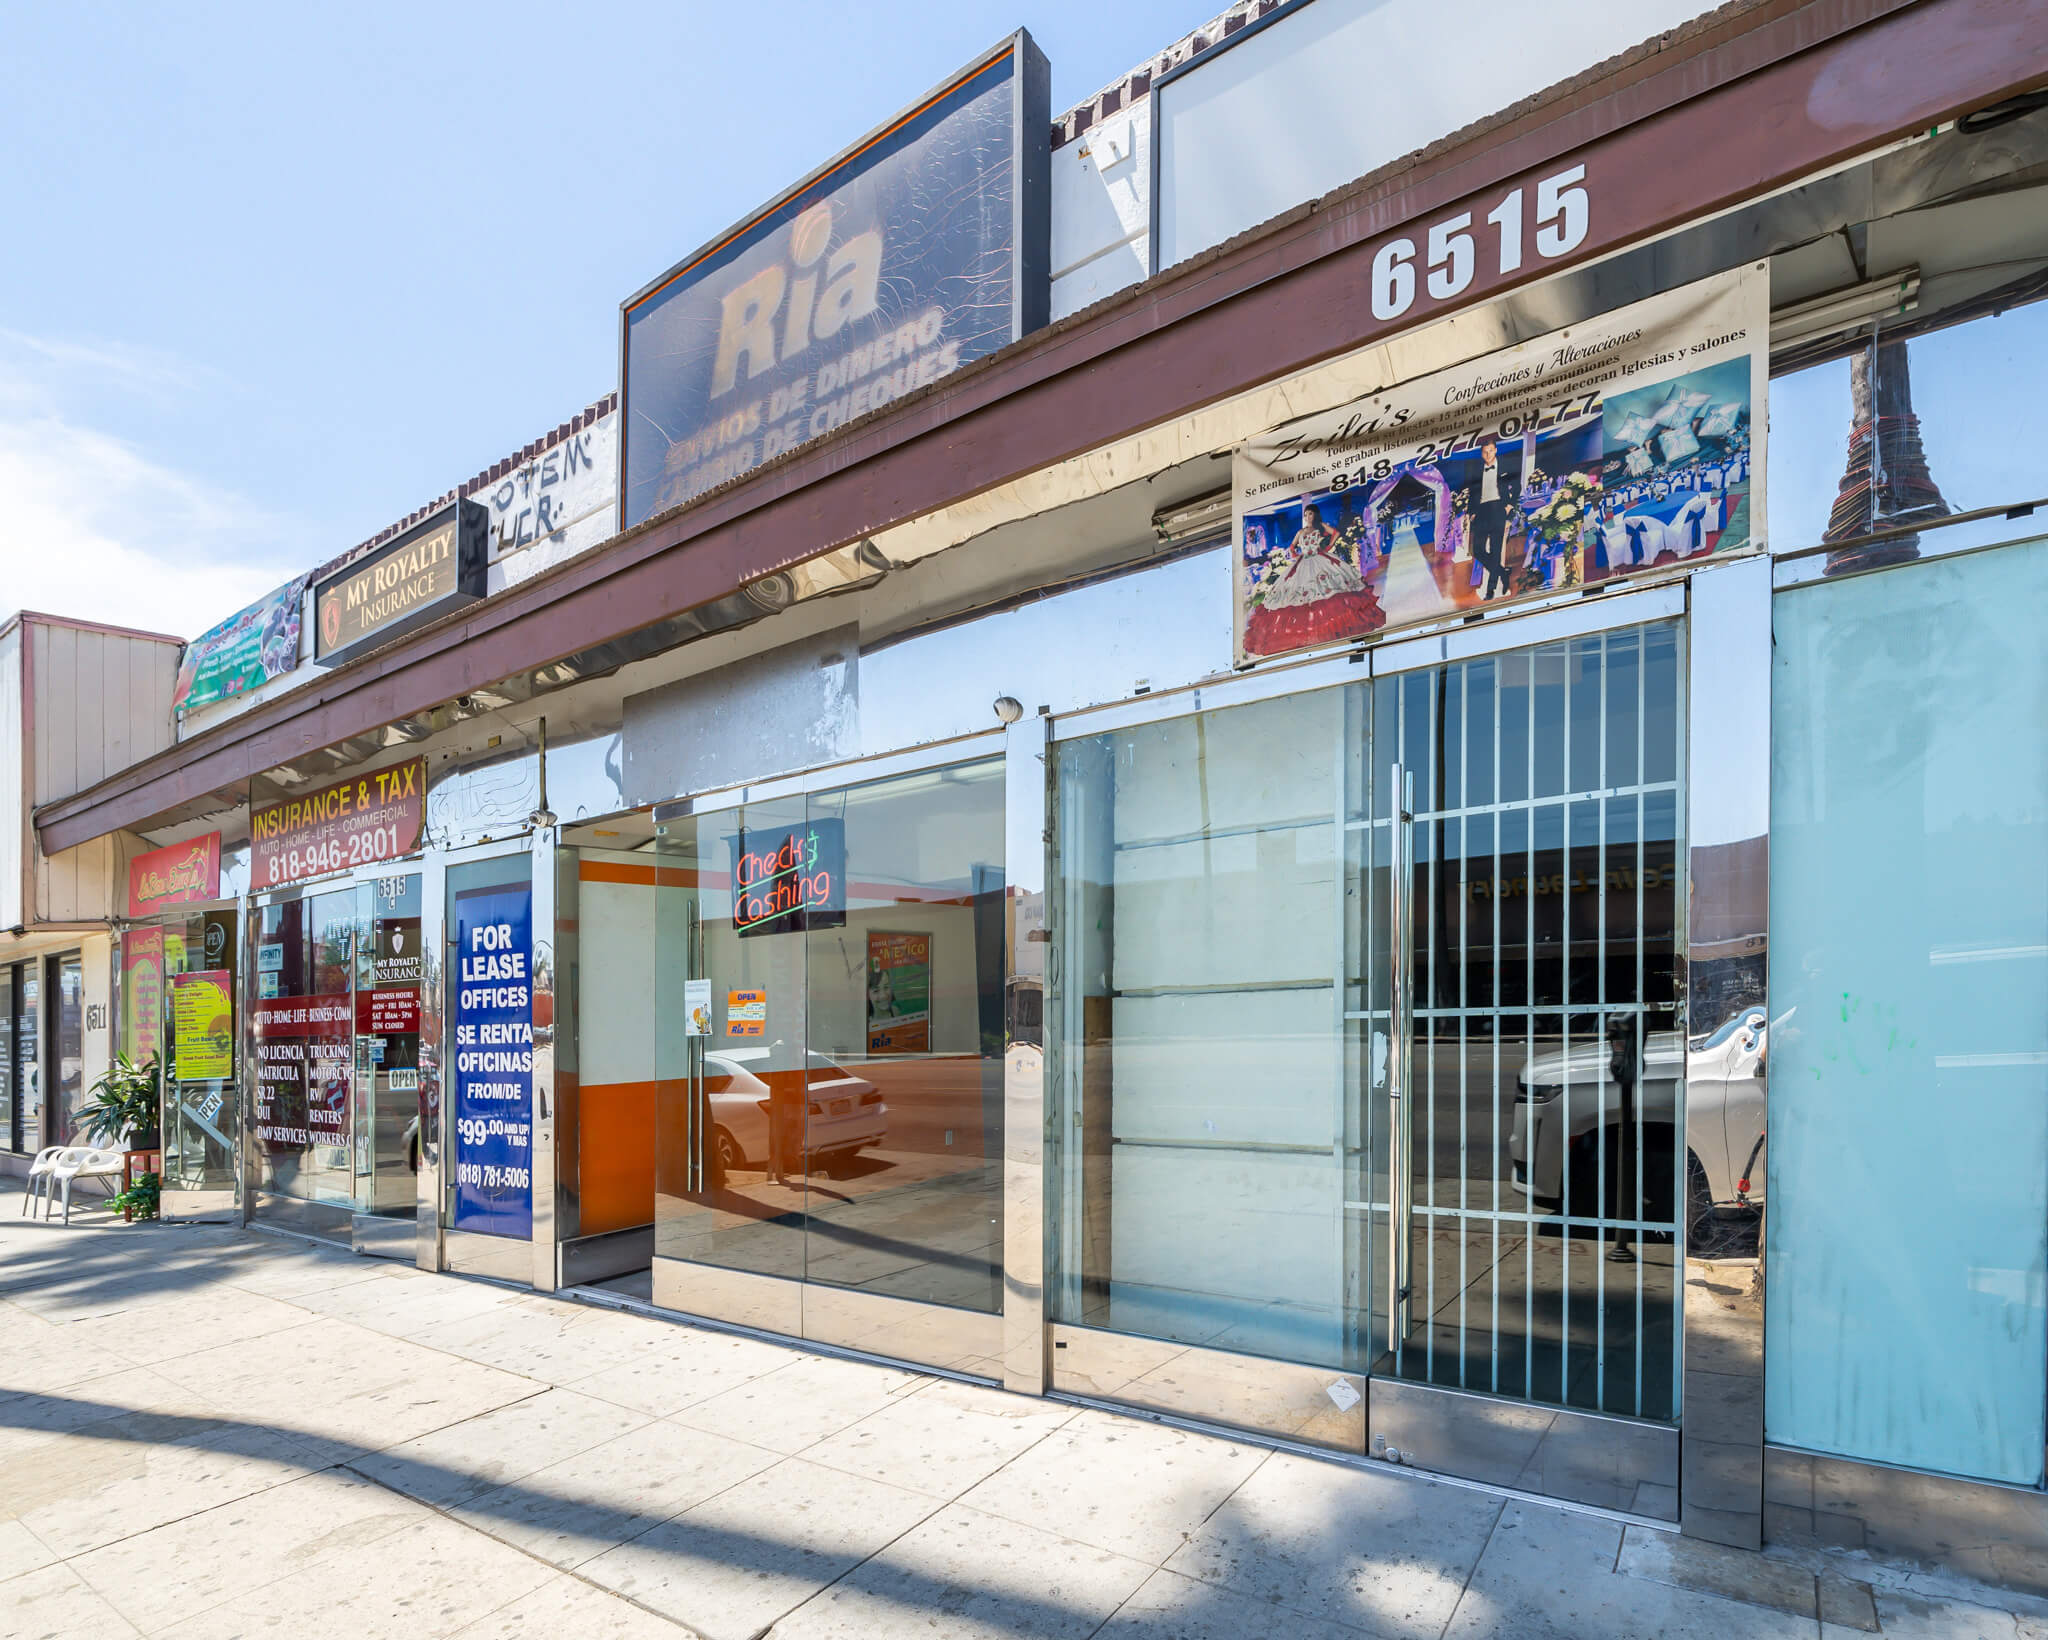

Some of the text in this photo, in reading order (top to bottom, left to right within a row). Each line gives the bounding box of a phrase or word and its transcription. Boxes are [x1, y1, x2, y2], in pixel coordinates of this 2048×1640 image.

[1371, 163, 1589, 321] 6515
[710, 200, 883, 400] Ria
[768, 377, 808, 425] DE
[815, 306, 944, 398] DINERO
[1444, 366, 1531, 406] Confecciones
[1550, 327, 1643, 370] Alteraciones
[809, 341, 961, 433] CHEQUES
[1245, 328, 1747, 498] Se Rentan trajes, se graban listones Renta de manteles se decoran Iglesias y salones
[1325, 354, 1621, 458] Todo para su fiestas 15 años bautizos comuniones
[1265, 404, 1416, 467] Zoila's
[1330, 458, 1392, 493] 818
[1415, 427, 1483, 466] 277
[347, 579, 369, 611] MY
[375, 531, 452, 595] ROYALTY
[361, 572, 435, 628] INSURANCE
[254, 764, 416, 842] INSURANCE & TAX
[260, 804, 408, 856] AUTO HOME LIFE COMMERCIAL
[269, 824, 398, 883] 818-946-2801
[379, 876, 405, 897] 6515
[390, 897, 395, 908] C
[735, 872, 829, 925] Cashing
[472, 925, 512, 952] FOR
[377, 957, 419, 968] MY ROYALTY
[462, 953, 526, 982] LEASE
[372, 966, 420, 981] INSURANC
[396, 991, 413, 999] HOURS
[399, 1001, 411, 1009] 10AM
[461, 986, 528, 1010] OFFICES
[87, 1002, 107, 1032] 6511
[372, 1012, 382, 1020] SAT
[372, 1022, 383, 1030] SUN
[457, 1023, 533, 1045] SE RENTA
[872, 1033, 891, 1049] Ria
[258, 1045, 304, 1060] NO LICENCIA
[310, 1044, 349, 1059] TRUCKING
[458, 1052, 532, 1073] OFICINAS
[257, 1066, 299, 1081] MATRICULA
[392, 1070, 416, 1088] OPEN
[257, 1086, 275, 1100] SR 22
[310, 1088, 320, 1102] RV
[467, 1083, 522, 1100] FROM/DE
[257, 1106, 270, 1120] DUI
[309, 1109, 342, 1124] RENTERS
[257, 1125, 307, 1144] DMV SERVICES
[309, 1130, 370, 1149] WORKERS CMP
[458, 1118, 503, 1146] $99.00
[504, 1123, 518, 1134] AND
[507, 1135, 527, 1147] Y MAS
[459, 1163, 529, 1189] (818) 781-5006
